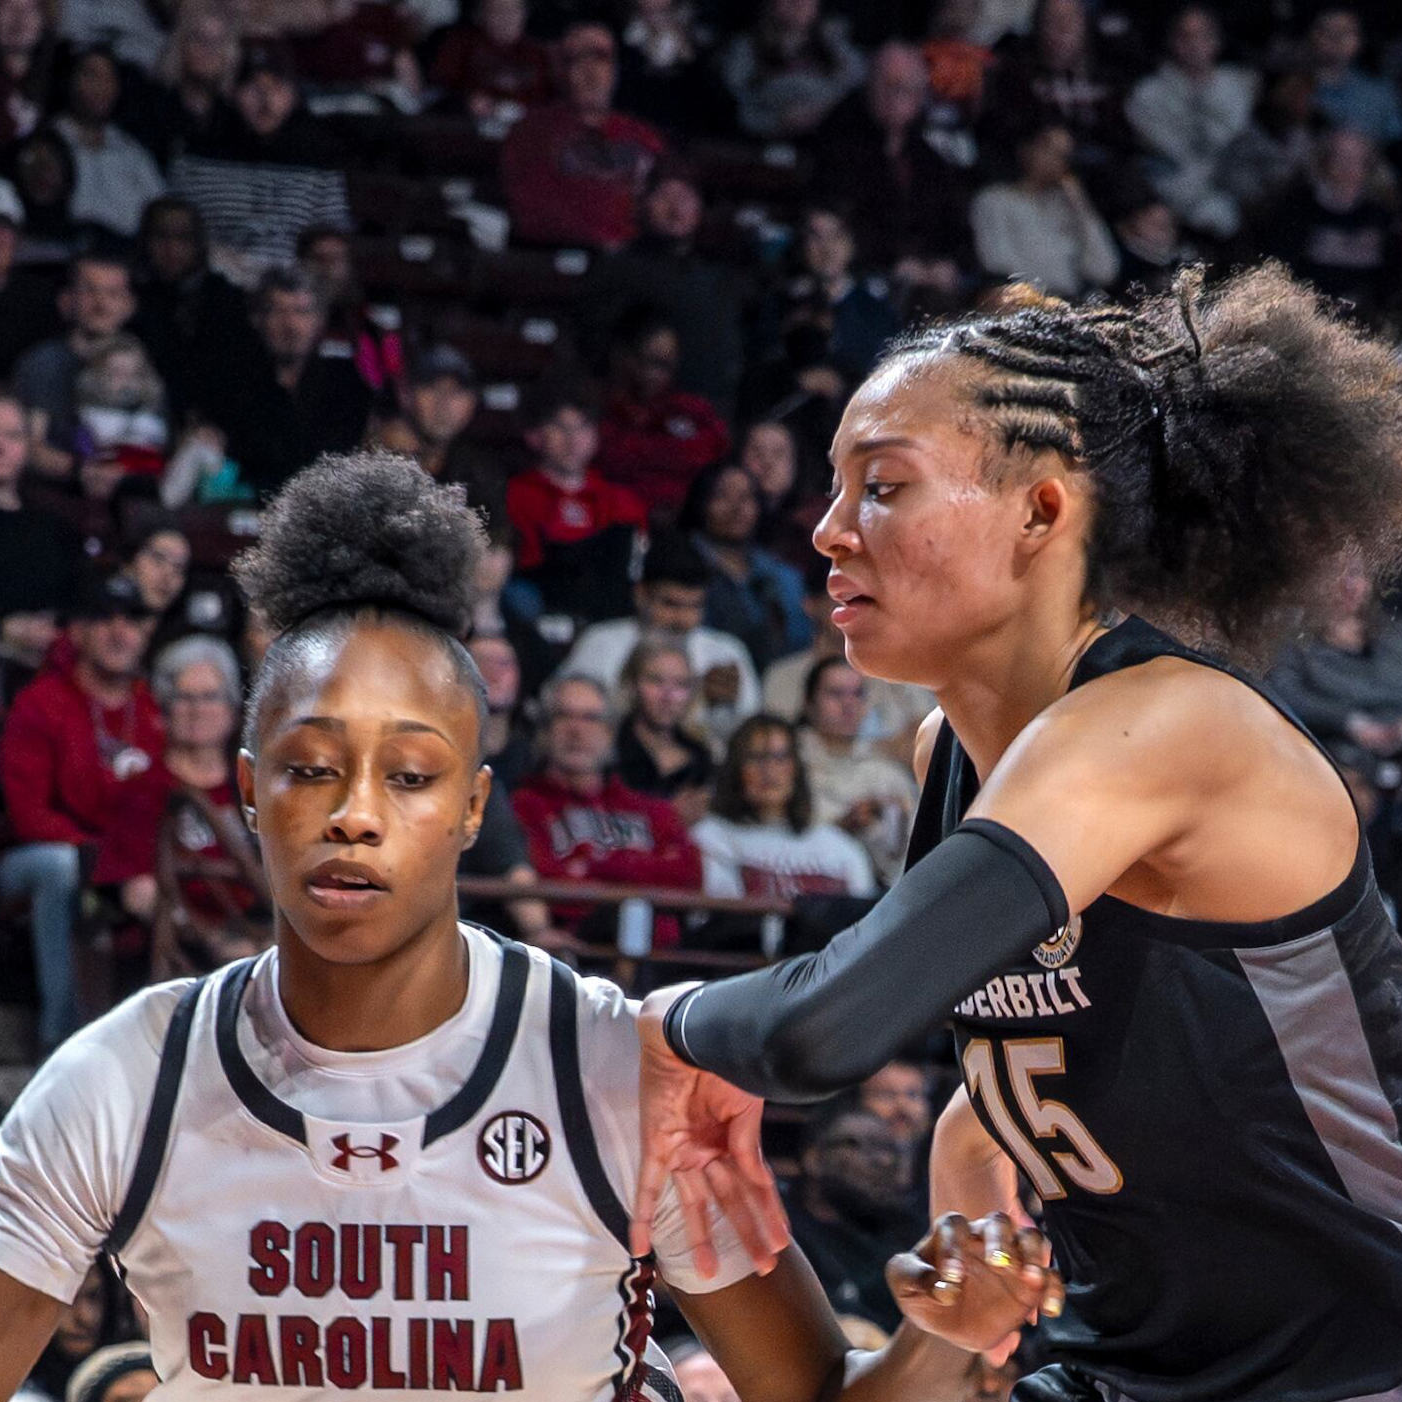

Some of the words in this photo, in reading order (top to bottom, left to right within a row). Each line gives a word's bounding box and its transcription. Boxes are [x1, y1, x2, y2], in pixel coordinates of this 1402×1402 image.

[482, 1115, 546, 1180] SEC
[962, 1036, 1124, 1200] 15
[247, 1219, 471, 1302] SOUTH
[187, 1310, 524, 1393] CAROLINA
